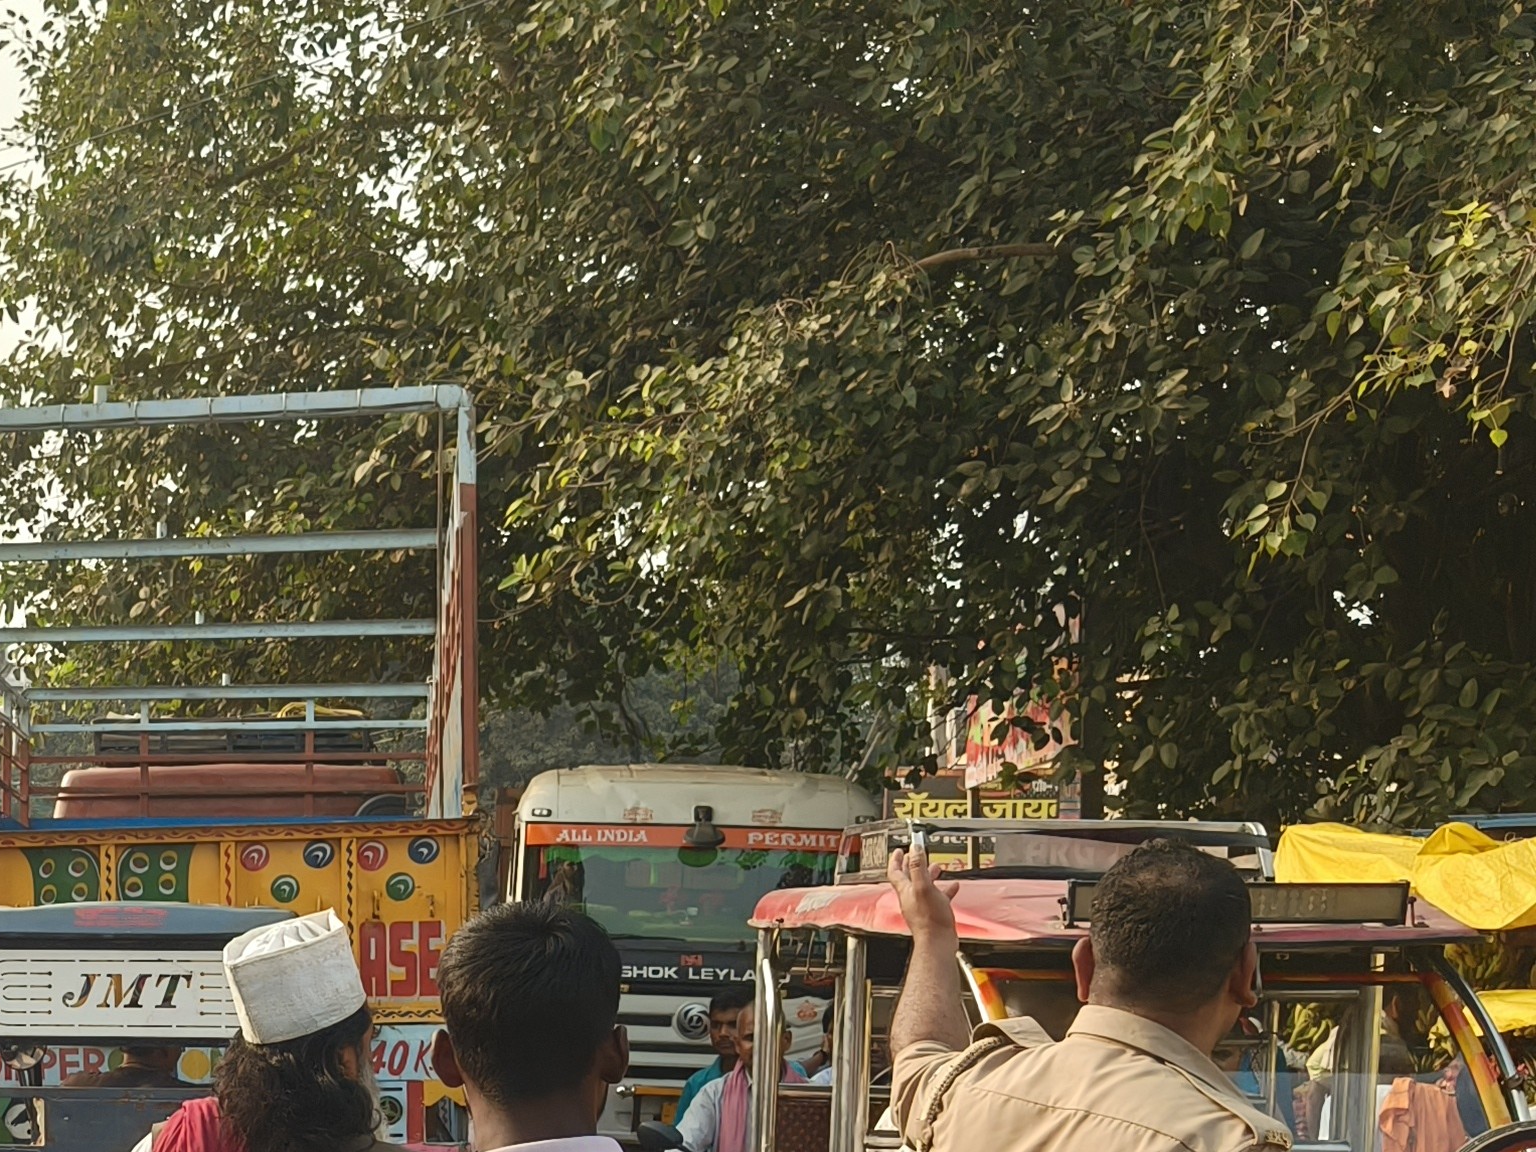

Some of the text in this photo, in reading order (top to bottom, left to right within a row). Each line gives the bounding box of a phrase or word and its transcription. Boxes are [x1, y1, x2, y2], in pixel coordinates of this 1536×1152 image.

[556, 829, 840, 848] ALL INDIA PERMIT
[62, 973, 193, 1009] JMT
